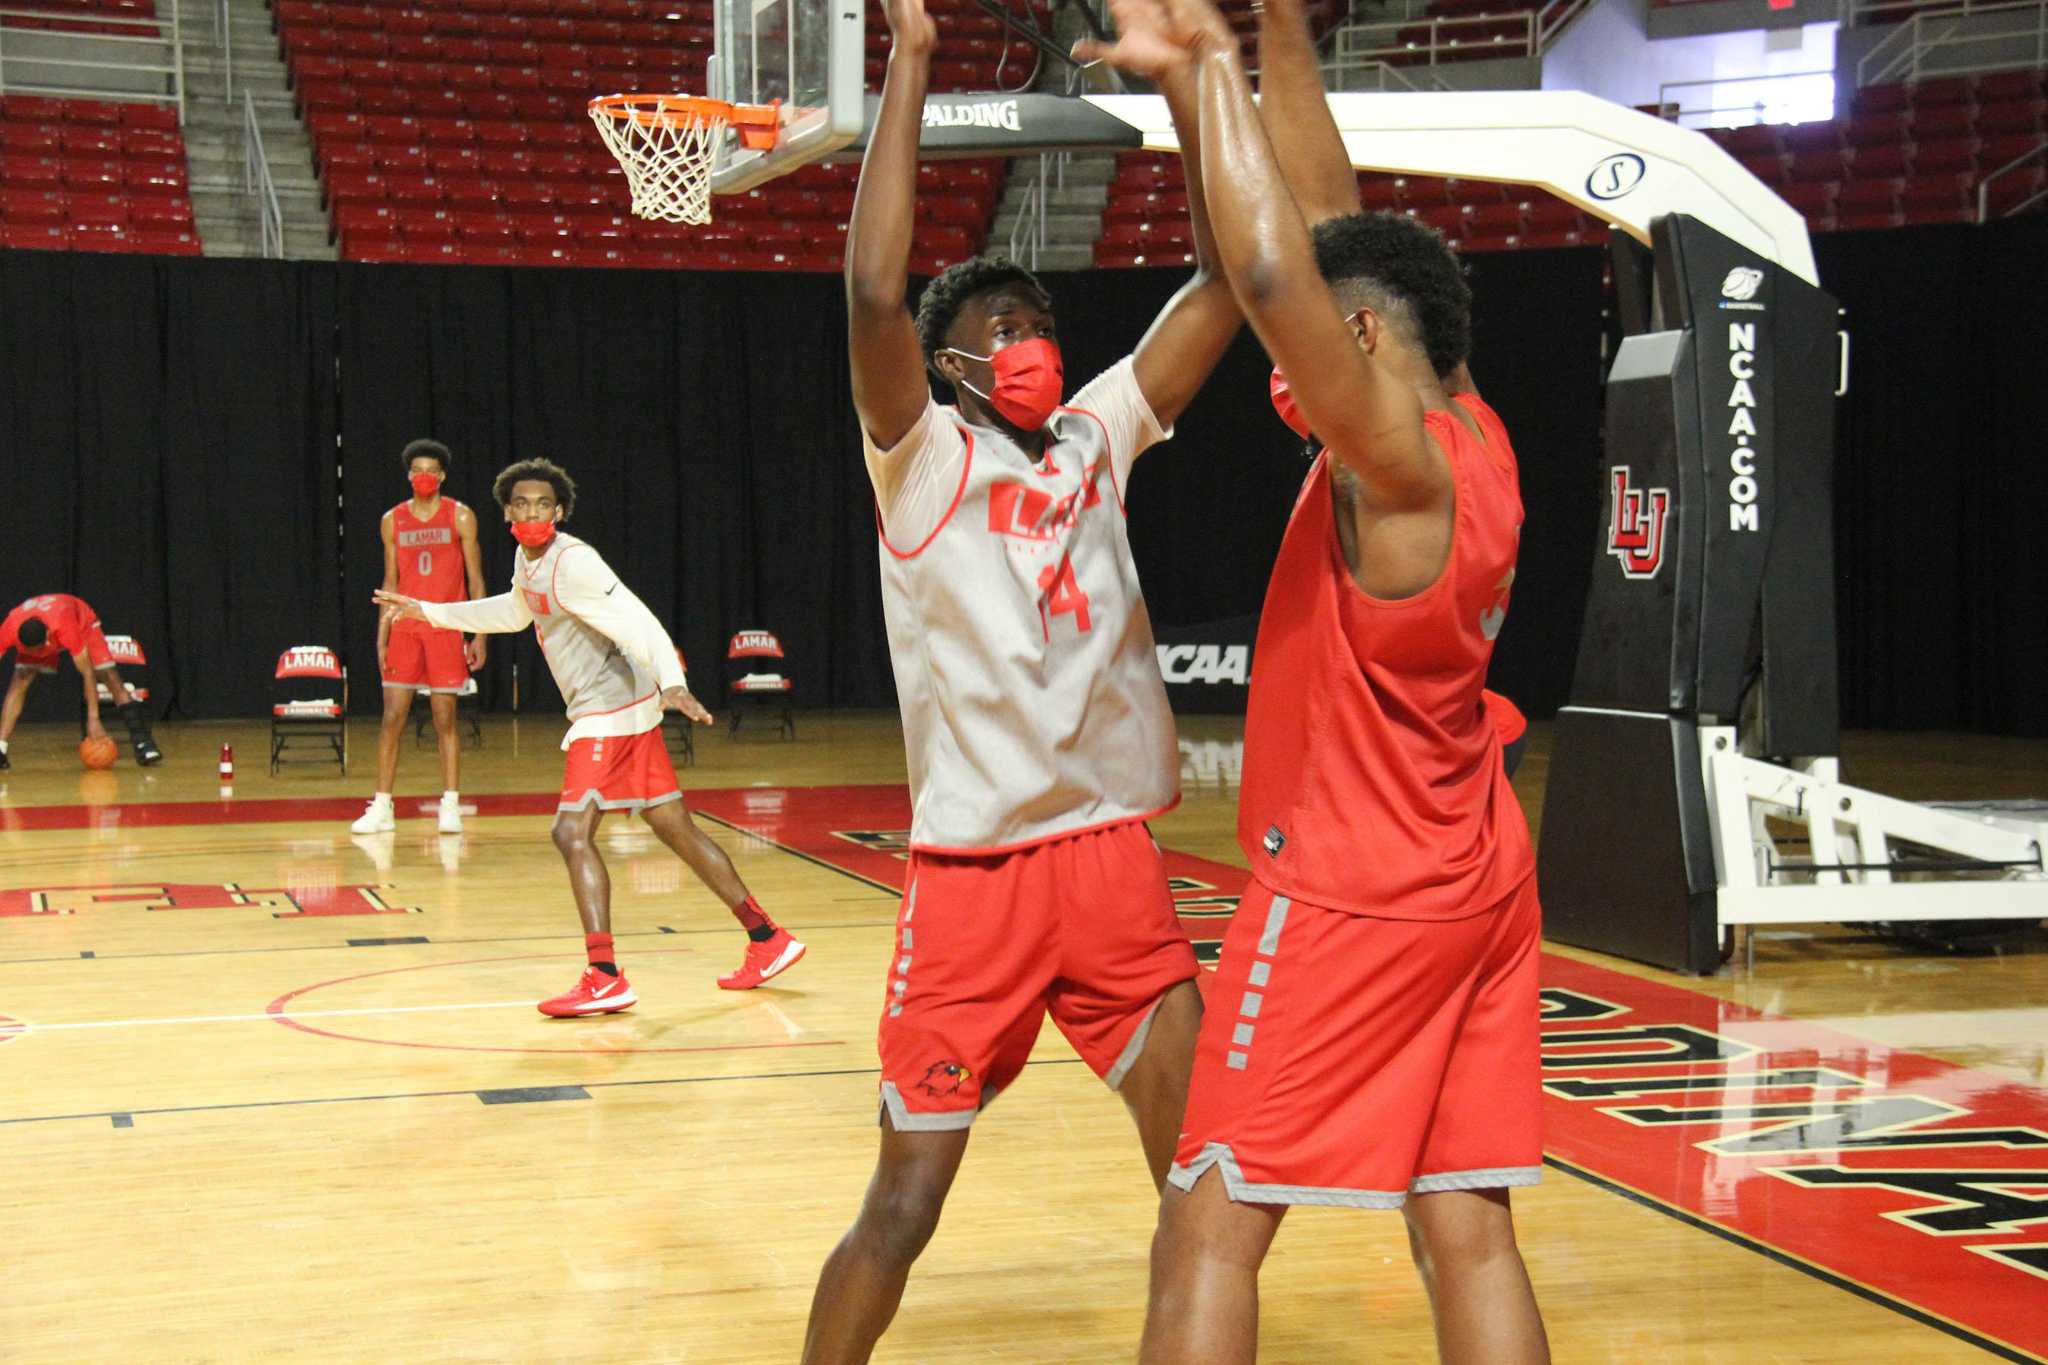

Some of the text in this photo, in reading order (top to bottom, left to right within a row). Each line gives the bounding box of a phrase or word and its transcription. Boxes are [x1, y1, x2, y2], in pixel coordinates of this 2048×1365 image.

[922, 100, 1022, 131] ALDING
[1727, 322, 1759, 532] NCAA.COM
[1607, 465, 1670, 580] LU
[418, 551, 432, 577] 0
[107, 640, 138, 656] MAR
[735, 634, 777, 650] LAMAR
[284, 652, 335, 670] LAMAR
